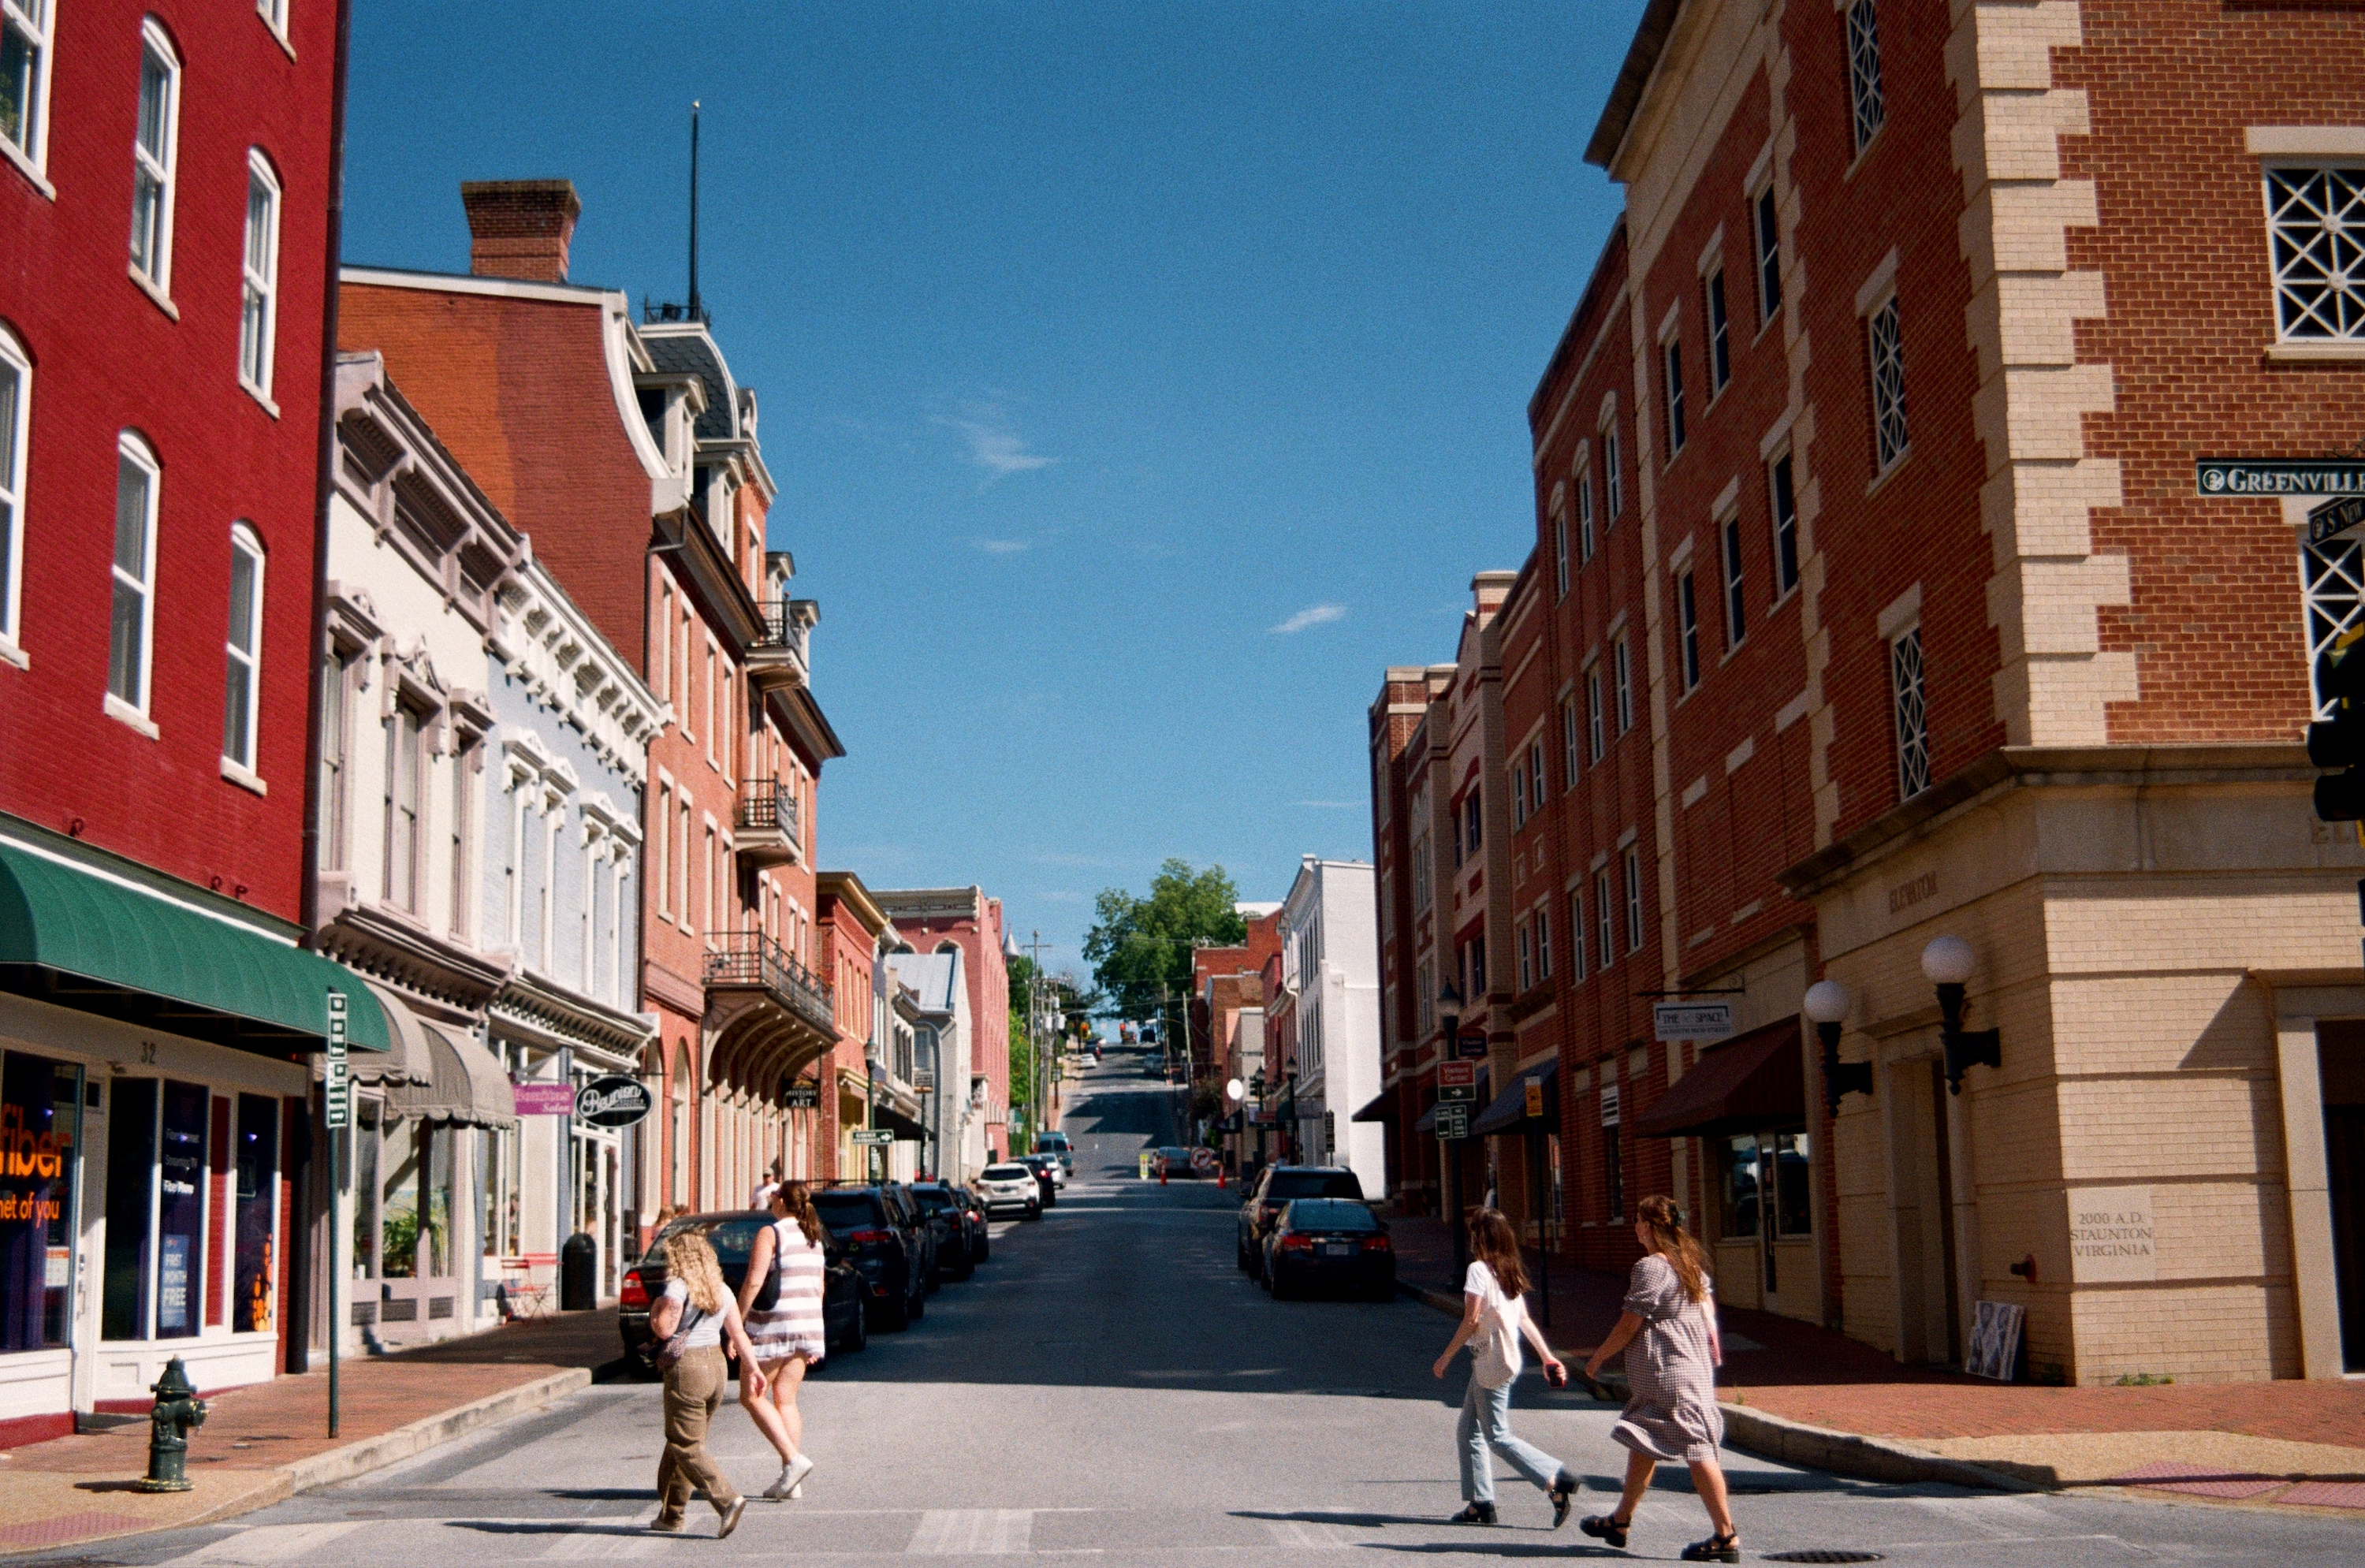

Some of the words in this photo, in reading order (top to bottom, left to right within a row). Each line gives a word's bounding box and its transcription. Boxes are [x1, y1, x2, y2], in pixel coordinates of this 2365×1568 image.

[2327, 512, 2336, 534] S
[1663, 1015, 1680, 1023] THE
[1695, 1012, 1724, 1022] SPACE
[140, 1041, 156, 1064] 32
[580, 1085, 642, 1117] Reunion
[791, 1098, 813, 1108] ART
[20, 1191, 34, 1220] of
[36, 1199, 60, 1229] you
[2080, 1212, 2110, 1224] 2000
[2070, 1227, 2151, 1241] STAUNTON
[2074, 1244, 2150, 1256] VIRGINIA
[163, 1287, 187, 1306] FREE
